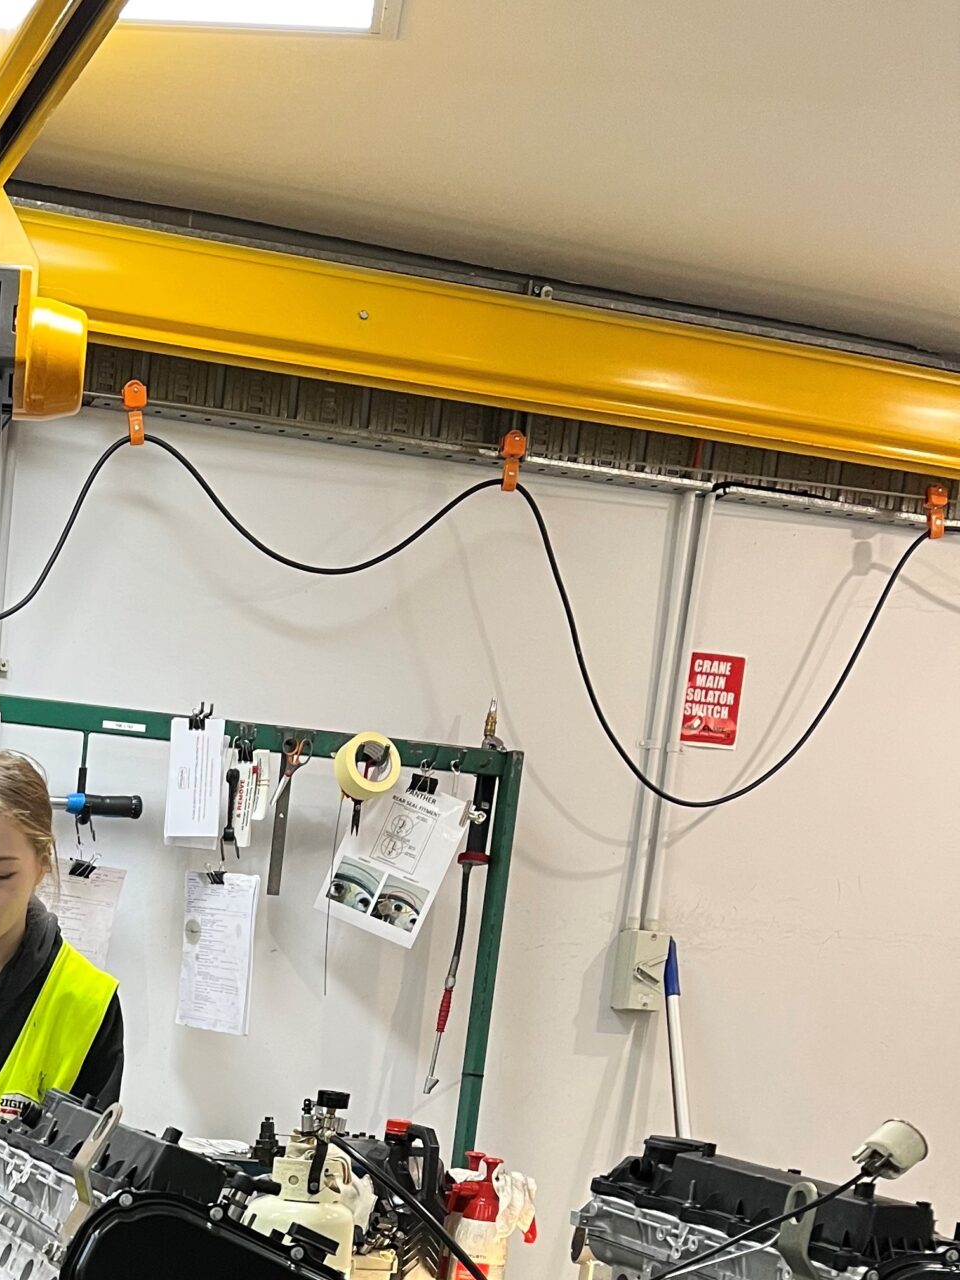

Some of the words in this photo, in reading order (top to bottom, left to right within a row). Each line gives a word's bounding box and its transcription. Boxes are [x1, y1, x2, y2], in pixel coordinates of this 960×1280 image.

[694, 659, 732, 675] CRANE
[696, 674, 727, 690] MAIN
[684, 702, 729, 719] SWITCH
[405, 787, 438, 806] PANTHER
[406, 800, 419, 811] SEAL
